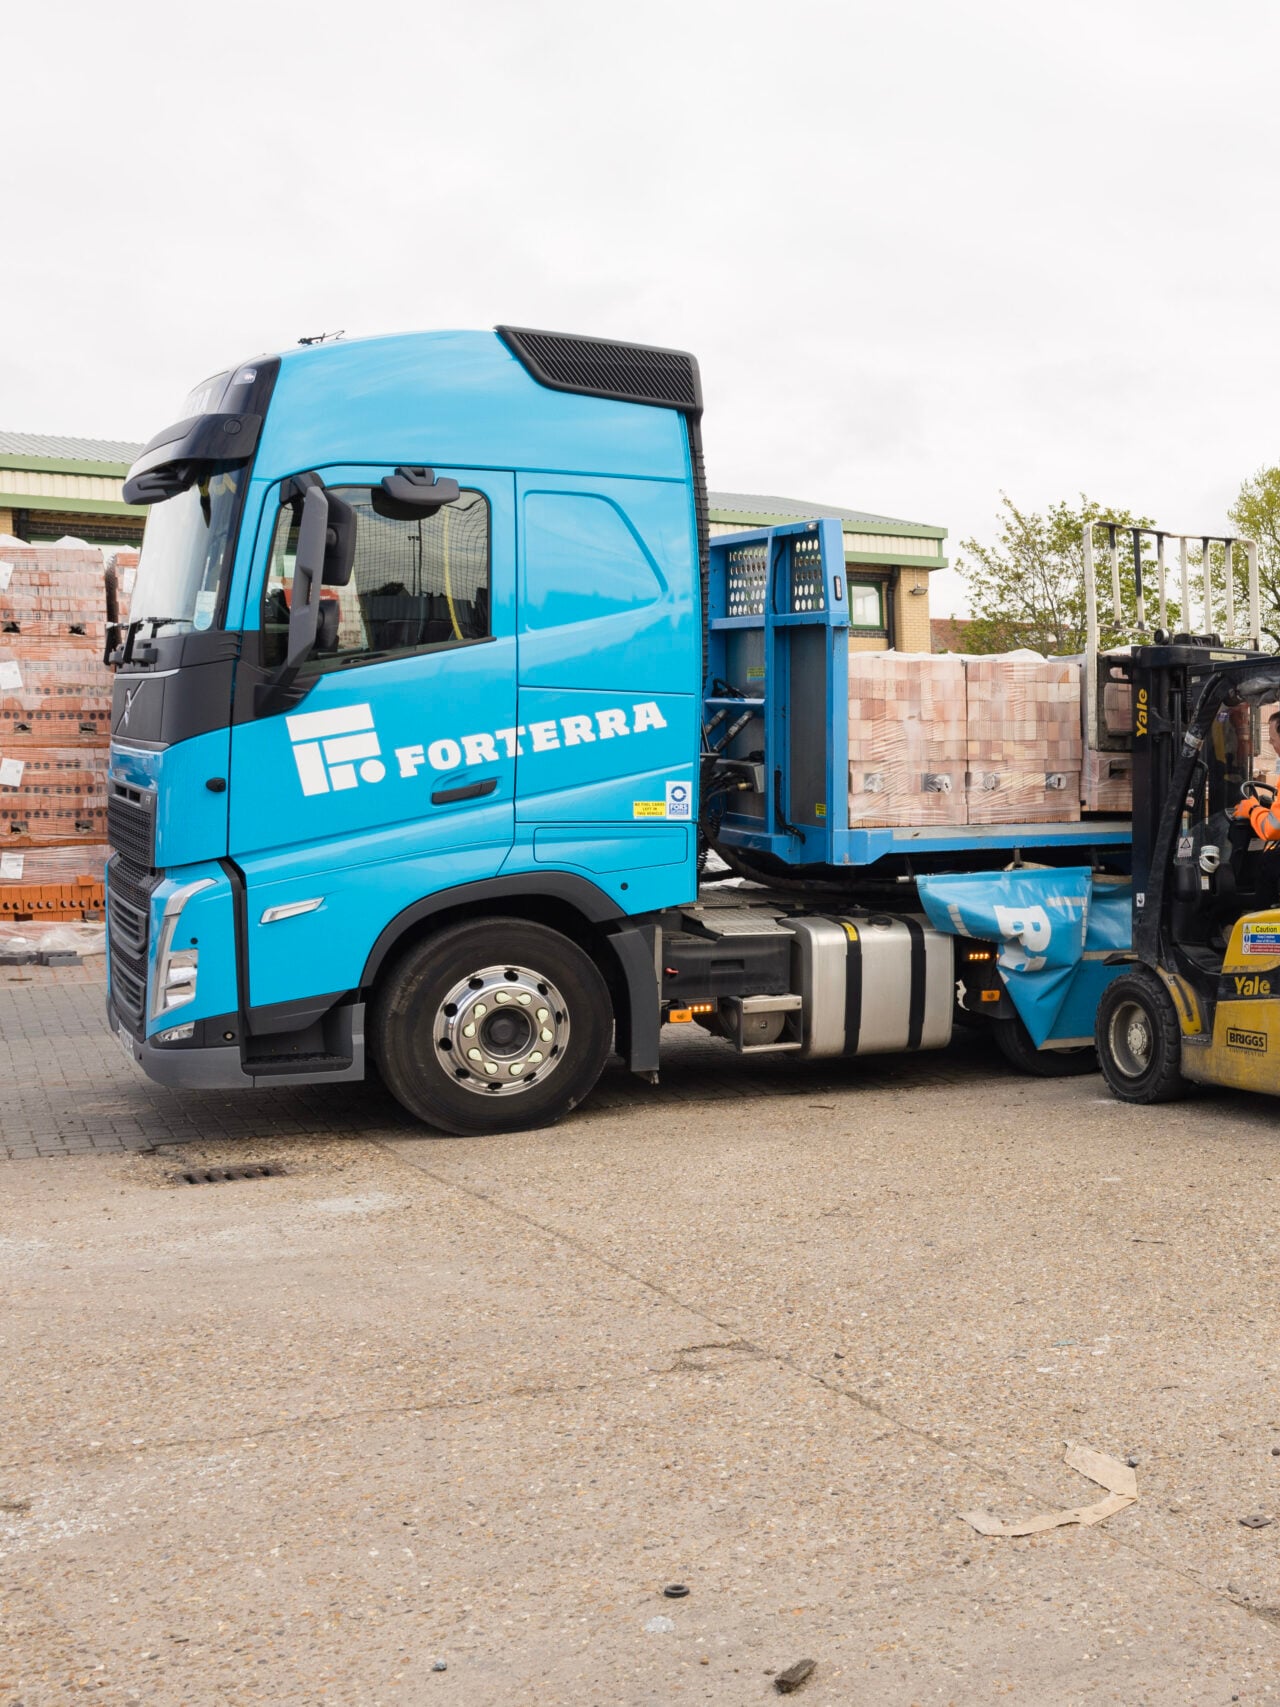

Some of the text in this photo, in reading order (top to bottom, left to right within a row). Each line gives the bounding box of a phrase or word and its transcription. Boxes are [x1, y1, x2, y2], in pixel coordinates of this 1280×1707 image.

[1136, 688, 1148, 737] Yale
[394, 701, 668, 778] FORTERRA
[1234, 976, 1271, 996] Yale
[1230, 1032, 1264, 1048] BRIGGS
